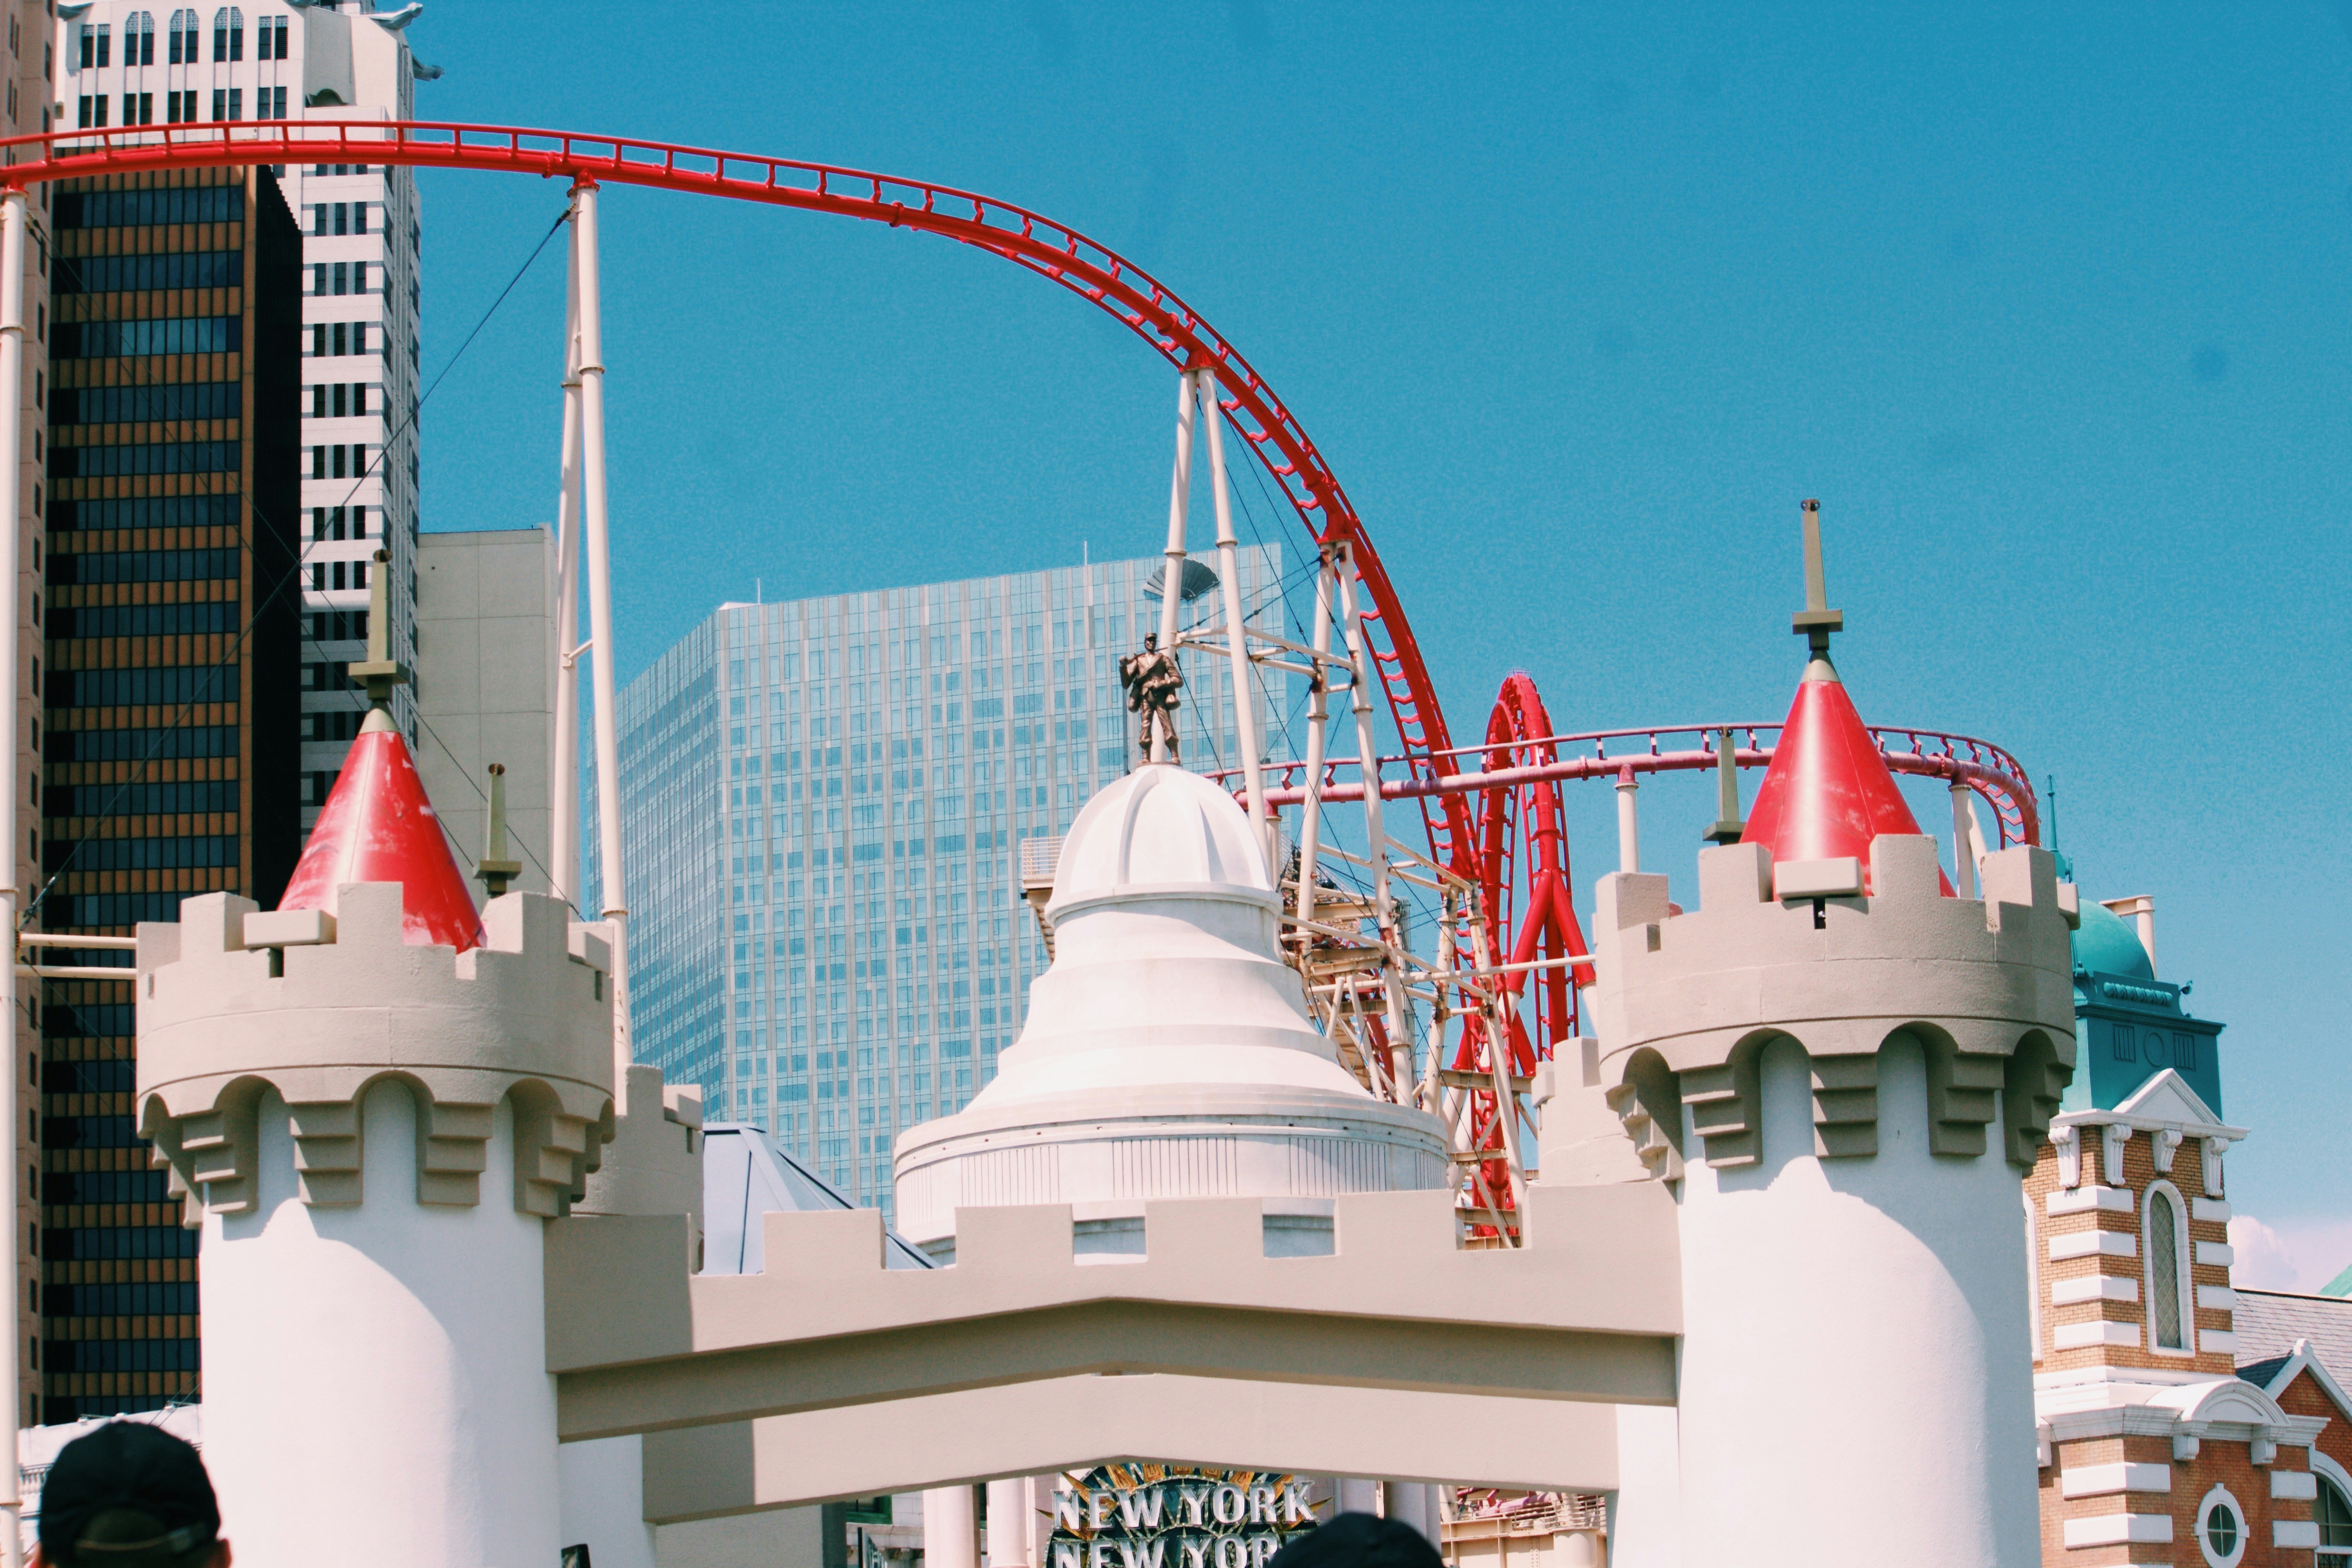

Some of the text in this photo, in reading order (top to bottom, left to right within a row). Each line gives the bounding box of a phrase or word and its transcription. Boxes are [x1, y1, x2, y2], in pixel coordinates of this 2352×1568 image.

[1051, 1480, 1320, 1530] NEW YORK
[1052, 1529, 1313, 1568] NEW YOR
